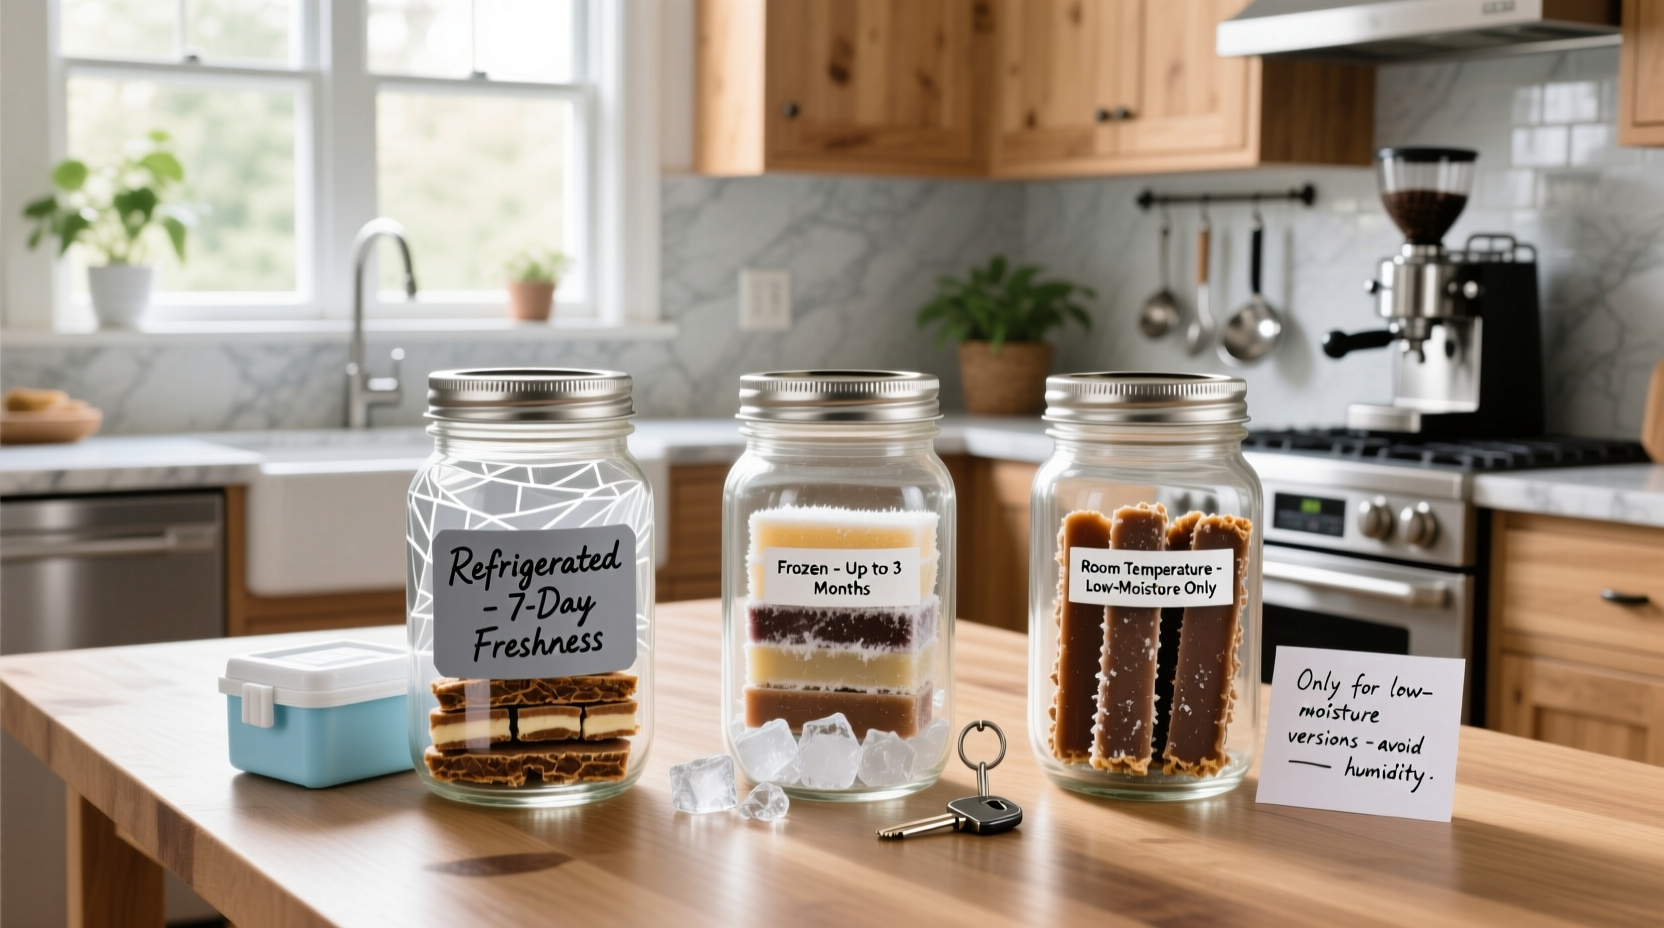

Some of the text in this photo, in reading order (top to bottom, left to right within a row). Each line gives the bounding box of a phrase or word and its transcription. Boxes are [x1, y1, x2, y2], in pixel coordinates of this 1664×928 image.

[449, 539, 622, 591] Refrigerated
[777, 560, 828, 575] Frozen
[846, 561, 868, 579] Up
[872, 561, 889, 575] to
[893, 561, 902, 574] 3
[1081, 559, 1121, 575] Room
[1123, 561, 1213, 580] Temperature
[814, 580, 871, 596] Months
[1184, 580, 1217, 599] Only
[508, 586, 597, 627] 7-Day
[473, 626, 604, 663] Freshness
[1297, 668, 1434, 701] Only for low-
[1288, 730, 1359, 749] versions
[1377, 735, 1426, 755] avoid
